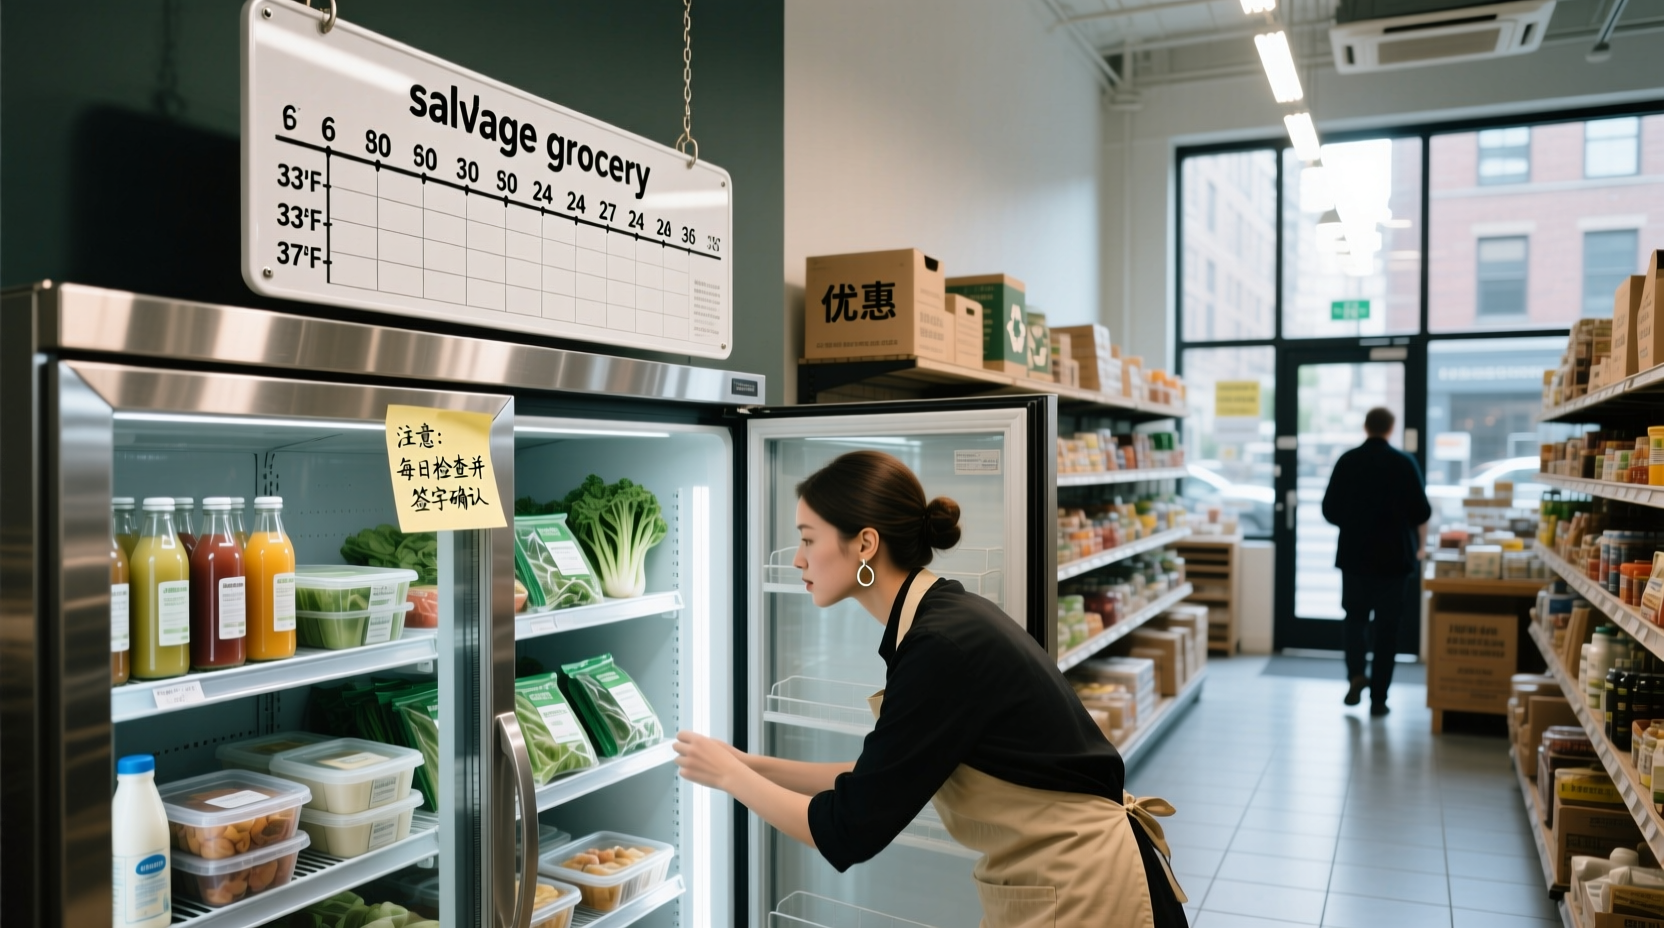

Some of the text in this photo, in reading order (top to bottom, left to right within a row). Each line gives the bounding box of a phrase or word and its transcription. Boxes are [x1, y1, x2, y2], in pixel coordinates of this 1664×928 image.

[282, 104, 297, 131] 6
[321, 116, 336, 142] 6
[456, 157, 480, 183] 30
[532, 180, 554, 205] 24
[566, 190, 586, 215] 24
[598, 200, 617, 222] 27
[627, 209, 645, 231] 24
[681, 226, 696, 245] 36
[546, 132, 651, 200] grocery
[820, 280, 897, 324] 优惠
[396, 453, 486, 481] 每日检查并
[410, 484, 490, 512] 签字确认
